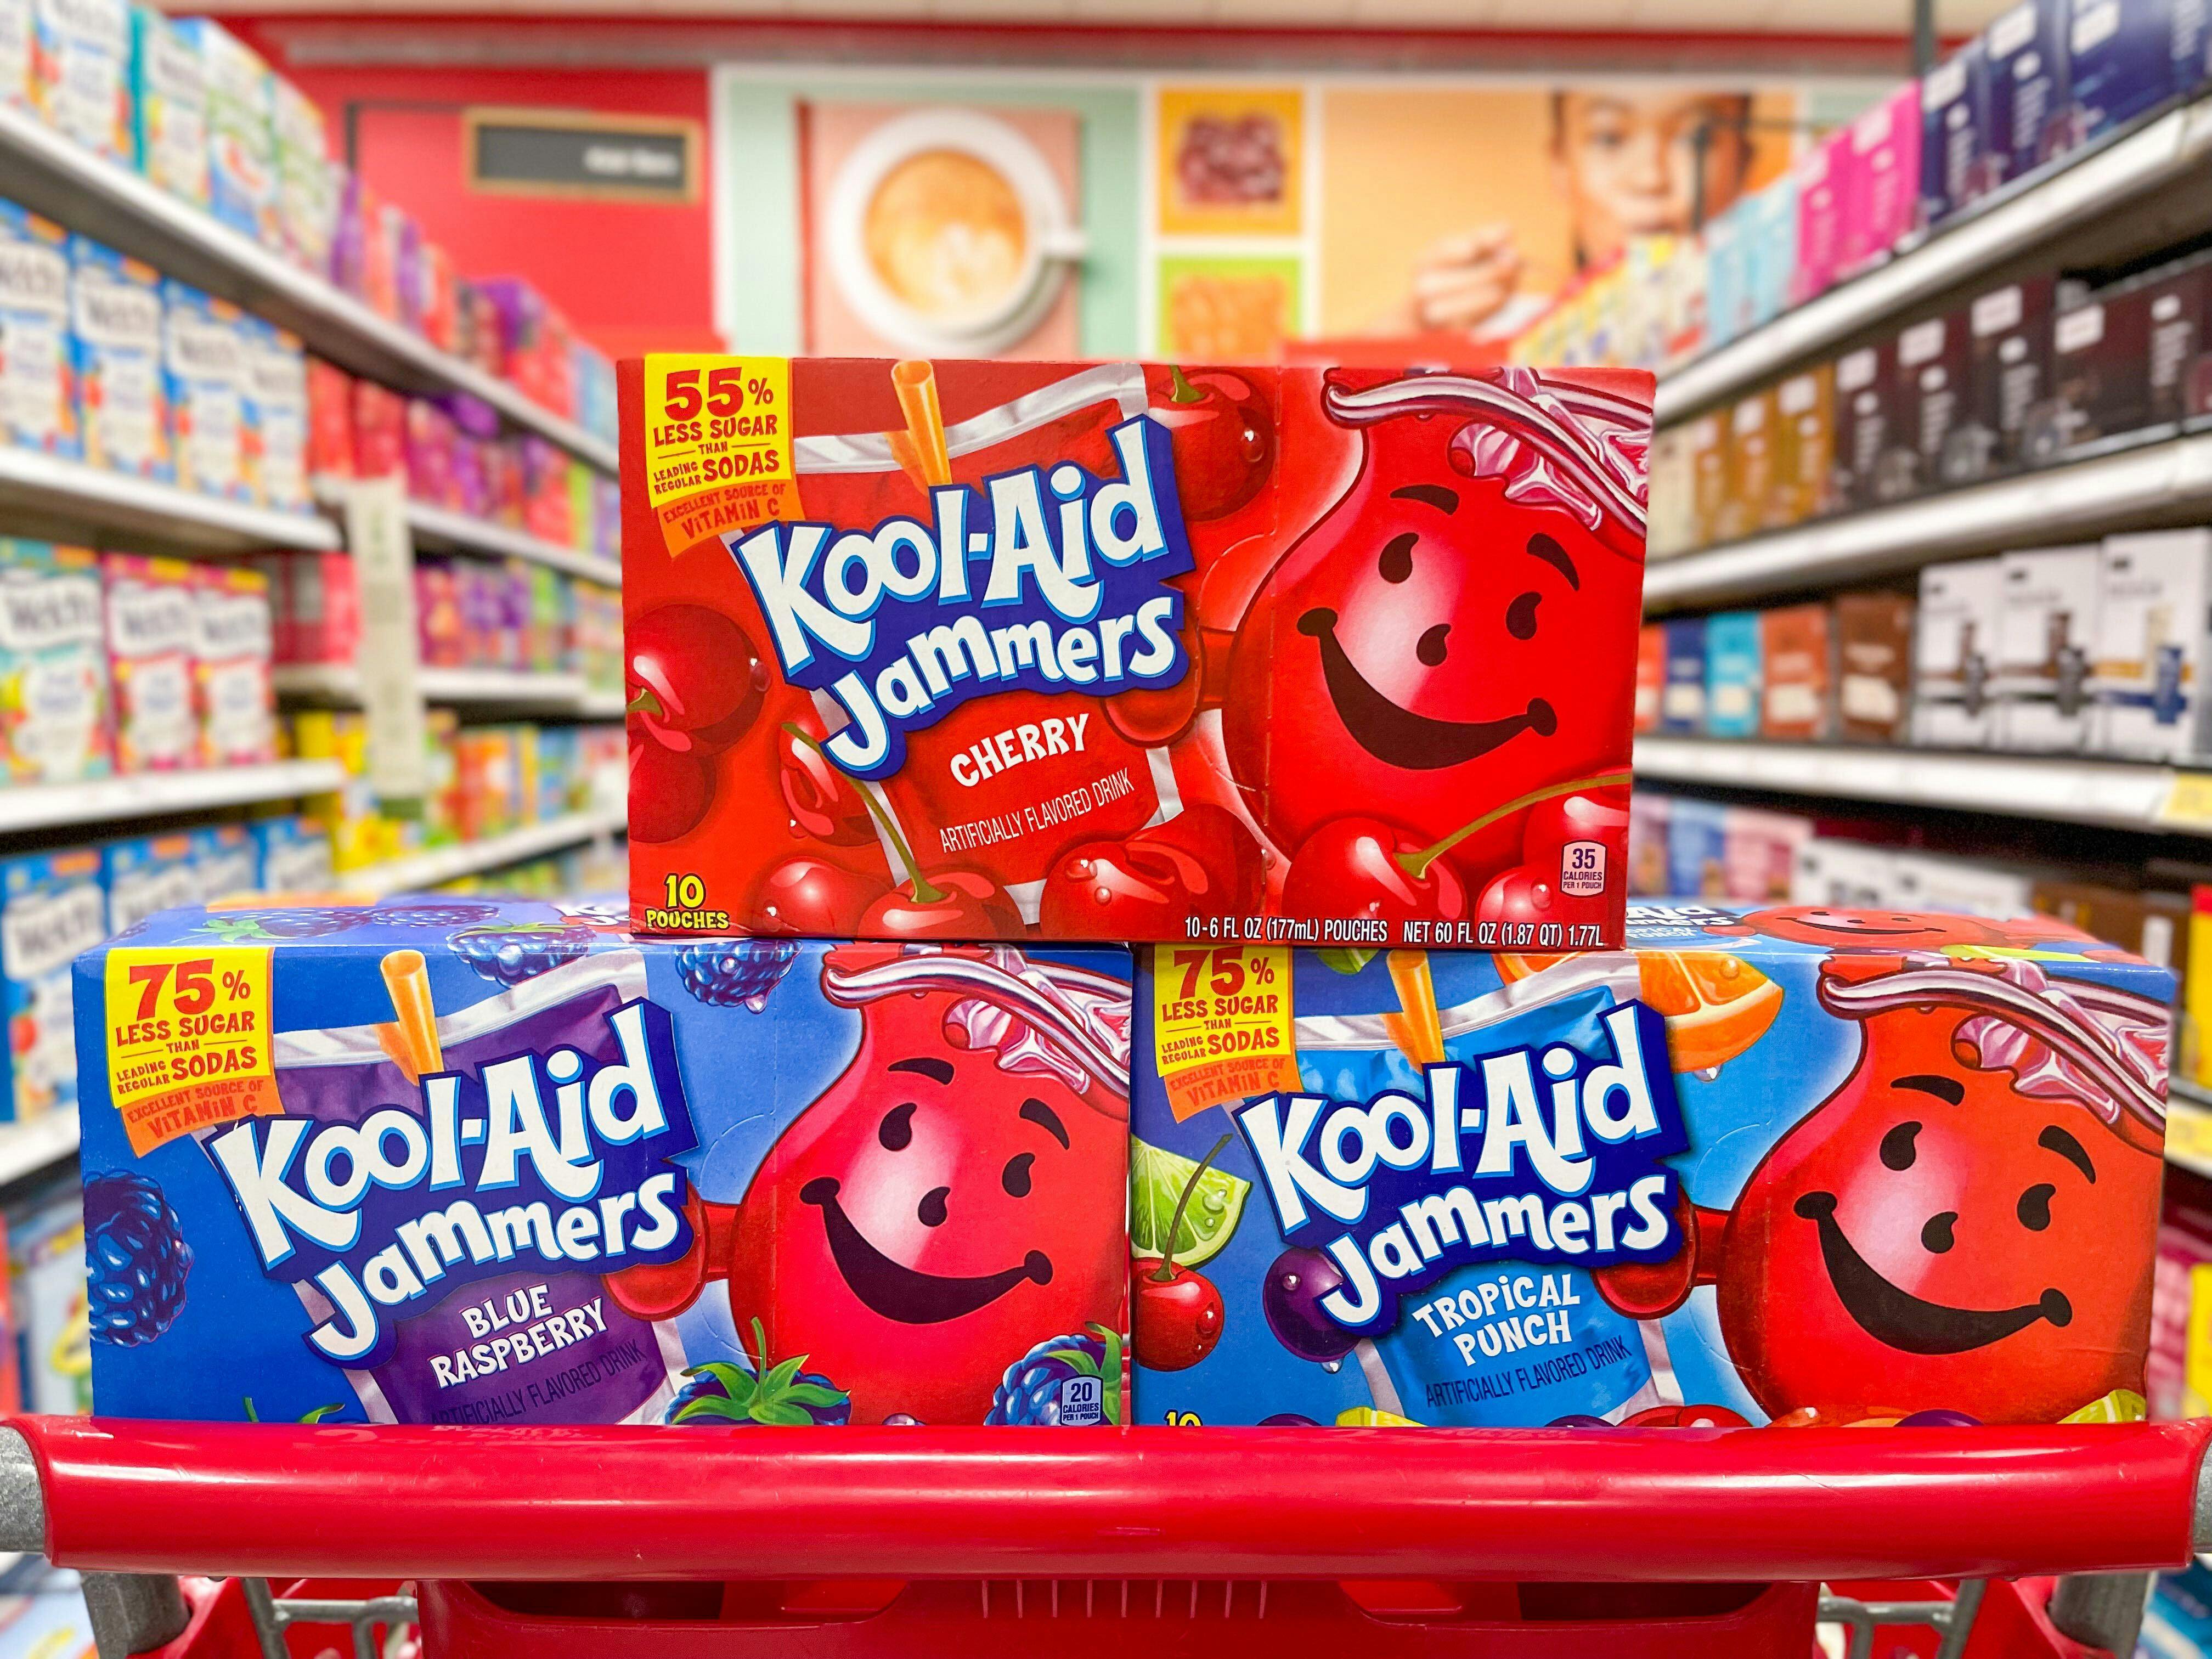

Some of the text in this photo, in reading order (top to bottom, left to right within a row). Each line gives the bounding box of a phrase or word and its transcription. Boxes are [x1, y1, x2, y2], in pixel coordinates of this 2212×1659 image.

[664, 367, 774, 421] 55%
[653, 414, 777, 447] LESS SUGAR
[698, 442, 727, 455] THAN
[703, 449, 780, 482] SODAS
[653, 475, 702, 495] REGULAR
[663, 483, 786, 524] EXCELLENT SOURCE OF
[767, 498, 780, 516] C
[740, 419, 1167, 674] Kool-Aid
[824, 596, 1176, 771] Jammers
[950, 714, 1089, 787] CHERRY
[939, 767, 1135, 853] ARTIFICIALLY FLAVORED DRINK
[1572, 848, 1595, 869] 35
[664, 873, 706, 909] 10
[1564, 871, 1602, 881] CALORIES
[646, 909, 729, 929] POUCHES
[1224, 917, 1239, 938] FL
[1244, 918, 1261, 939] OZ
[1267, 919, 1318, 941] (177mL)
[1324, 919, 1387, 942] POUCHES
[1403, 921, 1430, 943] NET
[1435, 922, 1452, 943] 60
[1458, 922, 1473, 944] FL
[1479, 923, 1496, 944] OZ
[1502, 923, 1534, 945] (1.87
[1540, 924, 1562, 947] QT)
[1568, 925, 1604, 946] 1.77L
[1626, 917, 1734, 926] mers
[129, 959, 251, 1021] 75%
[1174, 946, 1274, 1000] 75%
[1163, 995, 1278, 1022] LESS SUGAR
[1204, 1019, 1231, 1030] THAN
[116, 1011, 255, 1047] LESS SUGAR
[1207, 1027, 1279, 1055] SODAS
[166, 1039, 200, 1054] THAN
[172, 1046, 257, 1081] SODAS
[1161, 1048, 1206, 1064] REGULAR
[117, 1074, 171, 1094] REGULAR
[1169, 1058, 1285, 1090] EXCELLENT SOURCE OF
[1267, 1071, 1279, 1087] C
[126, 1080, 264, 1124] EXCELLENT SOURCE OF
[243, 1094, 258, 1112] C
[212, 1002, 669, 1270] Kool-Aid
[1239, 1006, 1660, 1235] Kool-Aid
[310, 1173, 679, 1361] Jammers
[1321, 1176, 1669, 1327] Jammers
[459, 1284, 554, 1339] BLUE
[428, 1295, 607, 1389] RASPBERRY
[1453, 1310, 1572, 1367] PUNCH
[527, 1361, 601, 1408] FLAVORED
[602, 1340, 647, 1376] DRINK
[1426, 1335, 1632, 1408] ARTIFICIALLY FLAVORED DRINK
[1063, 1403, 1099, 1413] CALORIES
[1070, 1383, 1092, 1402] 20
